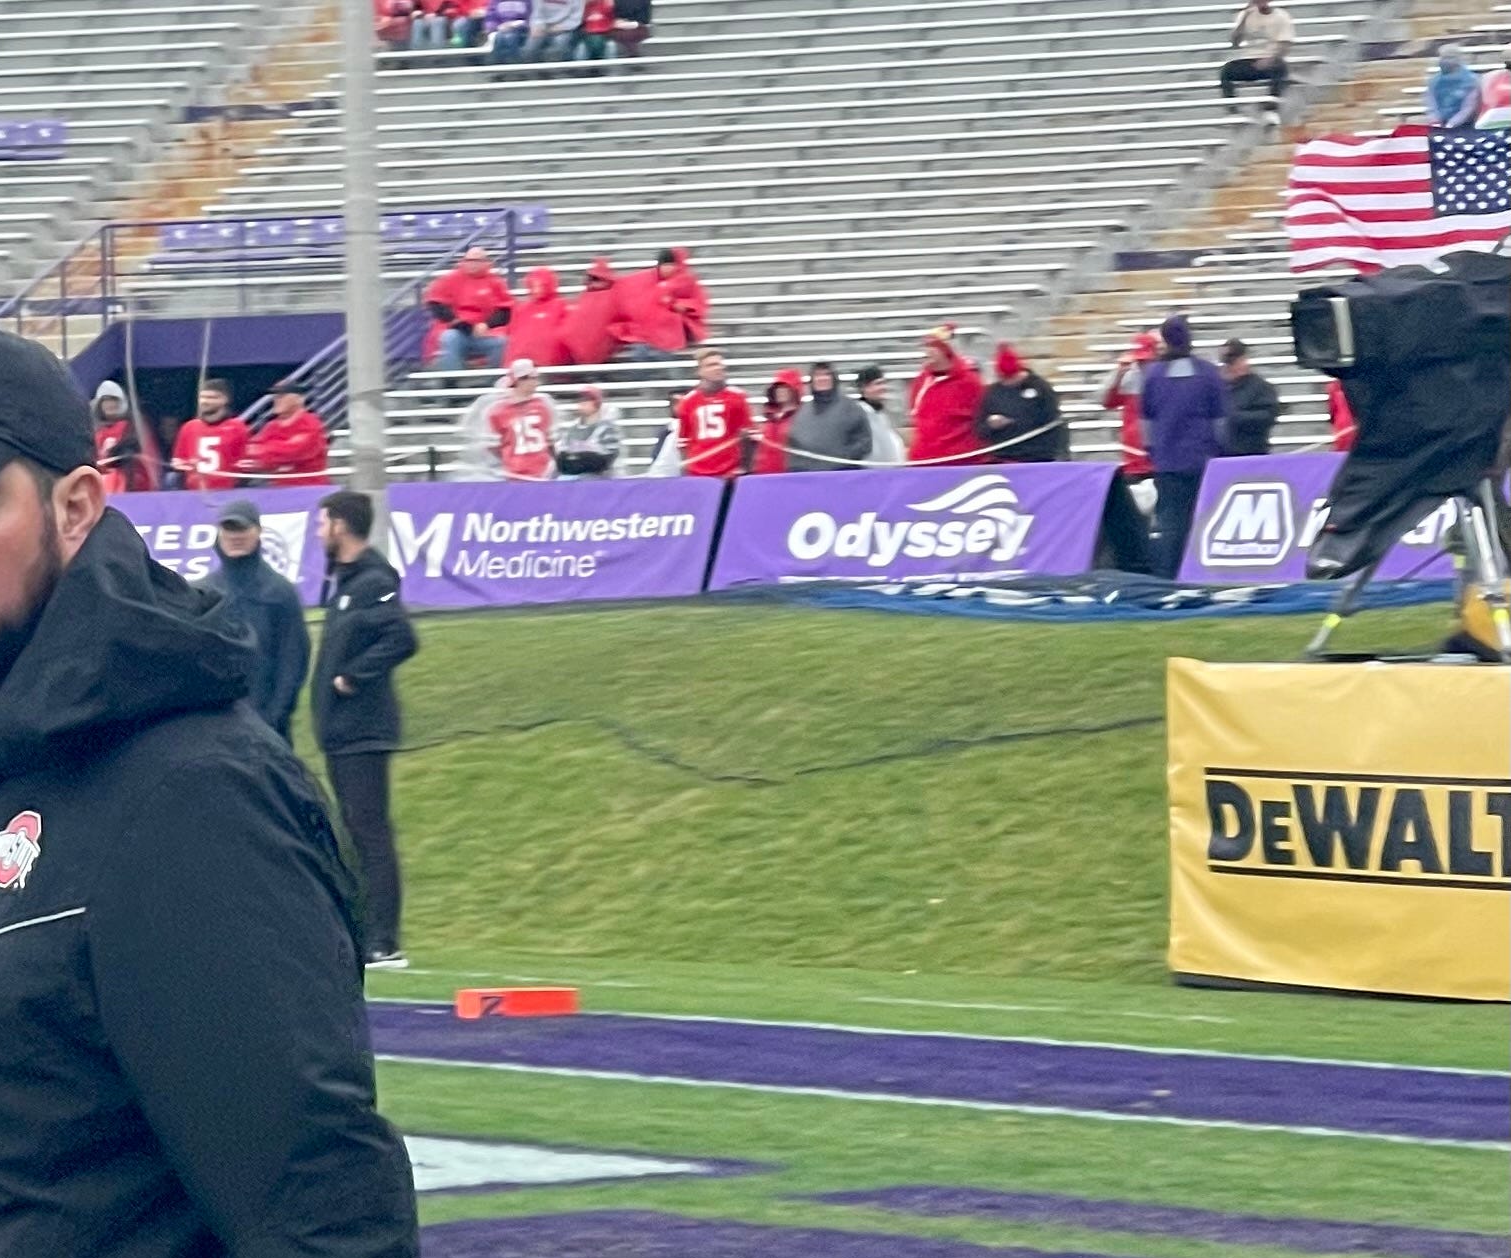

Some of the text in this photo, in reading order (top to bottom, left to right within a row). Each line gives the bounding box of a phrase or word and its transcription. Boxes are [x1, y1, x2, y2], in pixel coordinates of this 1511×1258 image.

[513, 415, 545, 454] 15
[697, 404, 727, 439] 15
[196, 436, 221, 472] 5
[462, 512, 695, 543] Northwestern
[1214, 493, 1281, 540] M
[788, 511, 1035, 566] Odyssey
[452, 549, 597, 579] Medicine
